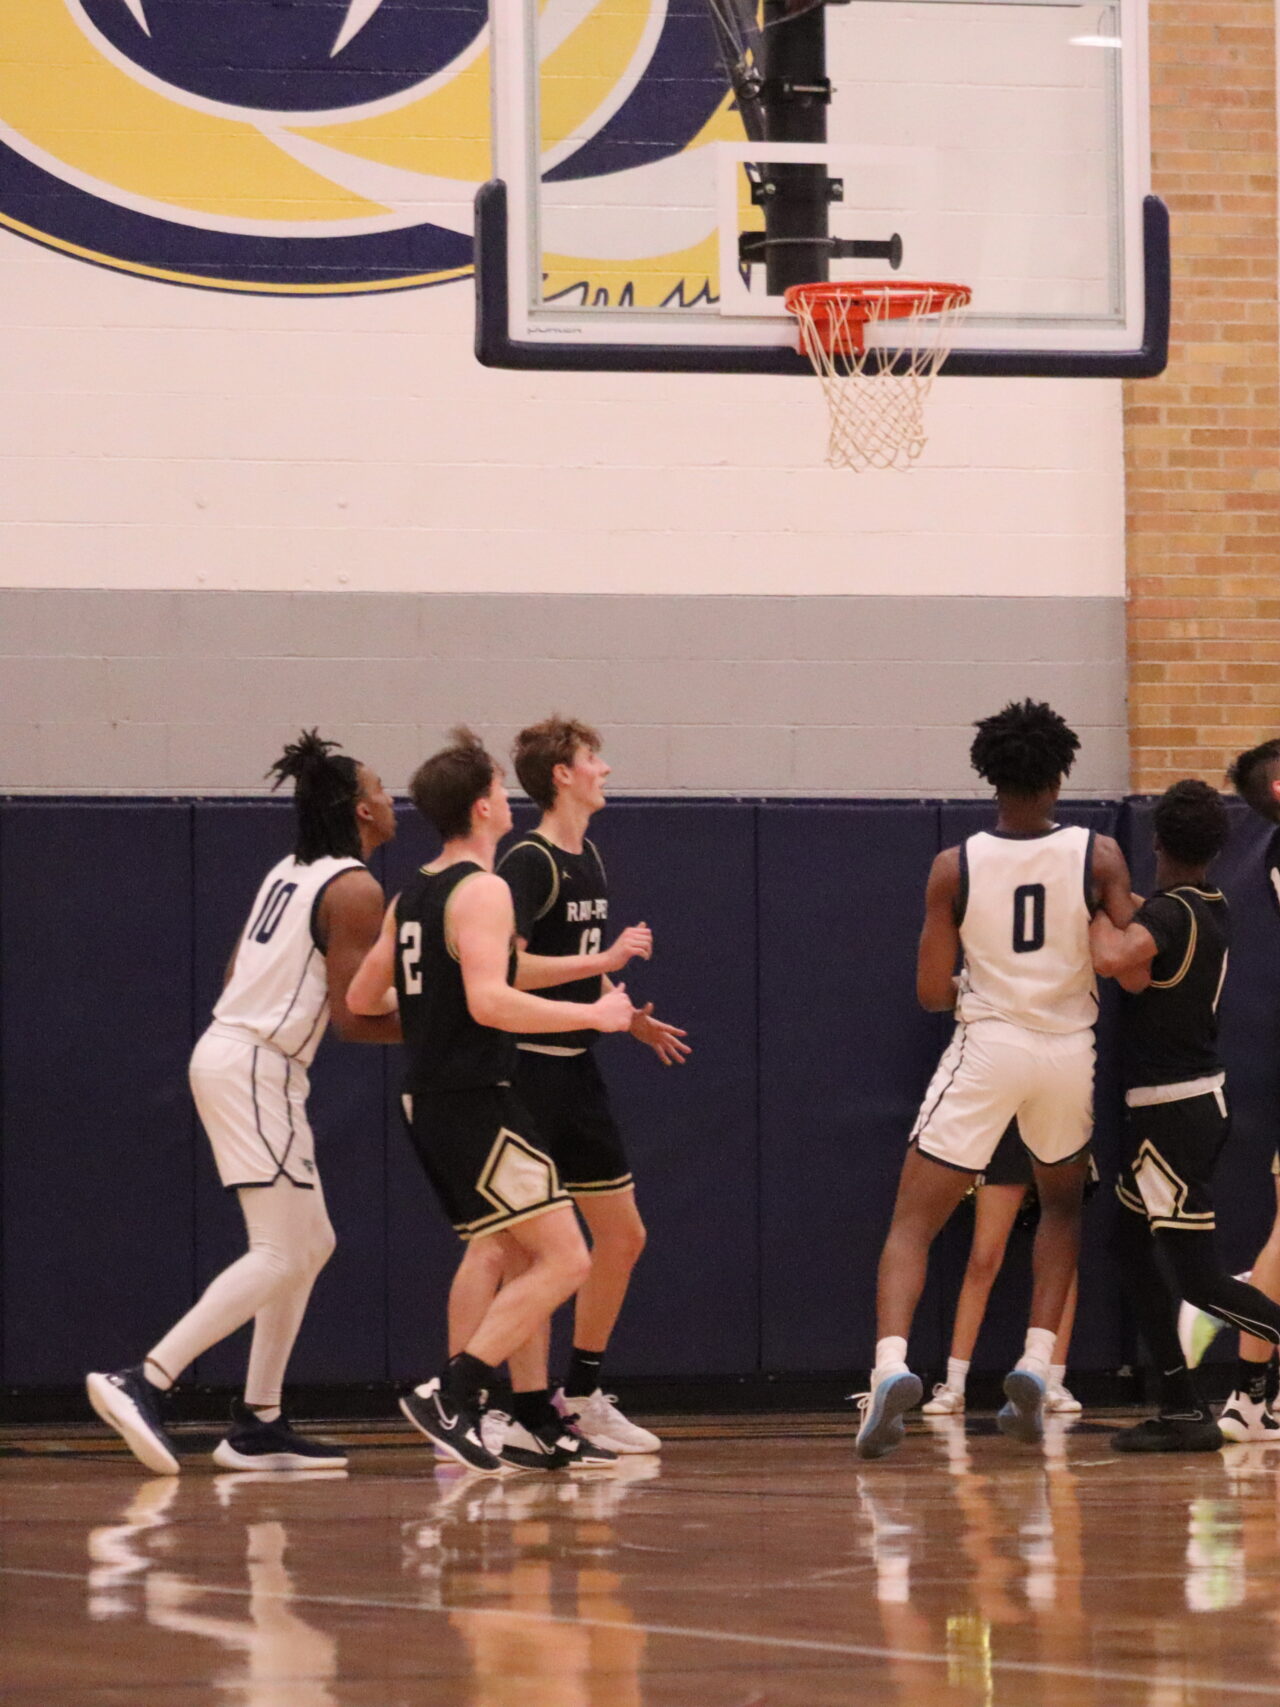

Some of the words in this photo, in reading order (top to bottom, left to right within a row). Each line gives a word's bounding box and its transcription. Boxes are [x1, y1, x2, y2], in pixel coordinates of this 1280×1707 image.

[248, 878, 299, 945] 10
[1012, 882, 1046, 954] 0
[400, 920, 422, 995] 2
